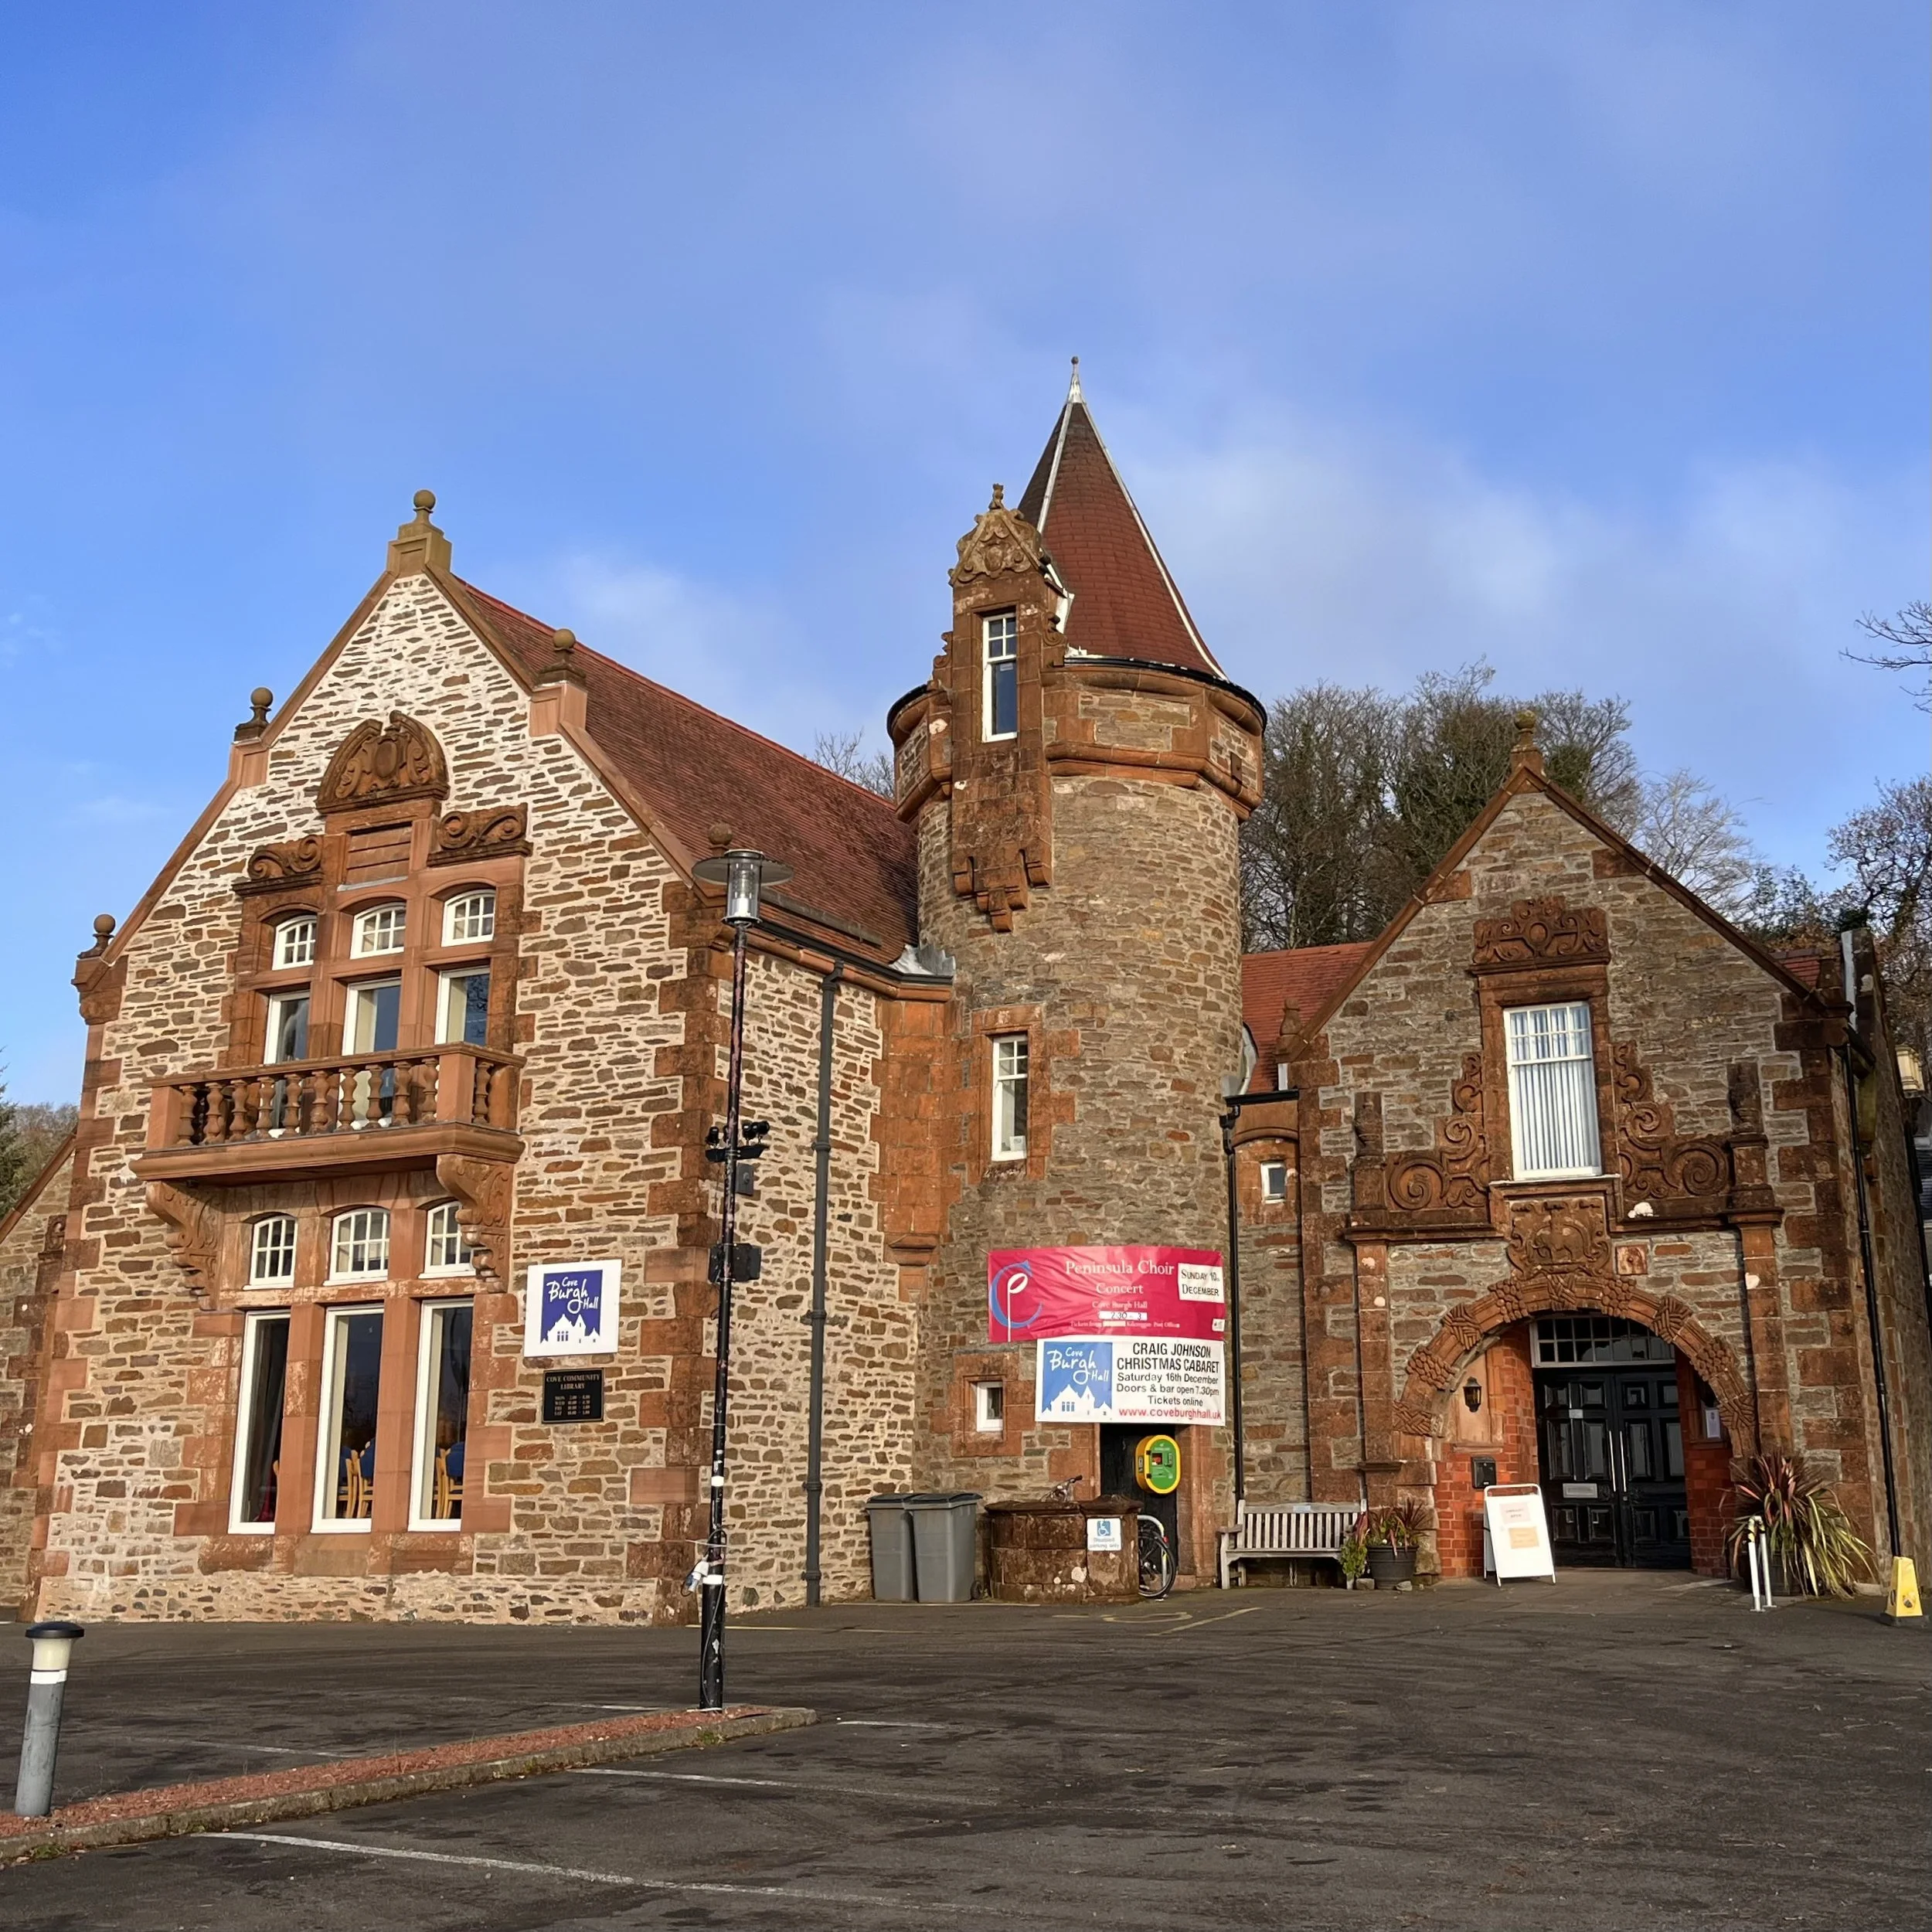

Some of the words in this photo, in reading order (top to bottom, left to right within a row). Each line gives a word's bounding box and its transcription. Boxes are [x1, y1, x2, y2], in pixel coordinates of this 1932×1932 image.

[1066, 1260, 1133, 1275] Peninsula
[1138, 1260, 1174, 1275] Choir
[562, 1277, 578, 1287] Cove
[1096, 1283, 1144, 1294] Concert
[546, 1278, 588, 1314] Burgh
[583, 1296, 599, 1309] Hall
[1066, 1347, 1083, 1356] Cove
[1133, 1342, 1168, 1355] CRAIG
[1171, 1343, 1211, 1358] JOHNSON
[1046, 1349, 1097, 1385] Burgh
[1117, 1358, 1182, 1370] CHRISTMAS
[1183, 1359, 1219, 1373] CABARET
[563, 1373, 600, 1382] COMMUNITY
[1091, 1369, 1109, 1382] Hall
[1117, 1372, 1163, 1383] Saturday
[1166, 1372, 1182, 1382] 16th
[1184, 1373, 1219, 1384] December
[1116, 1383, 1147, 1393] Doors
[1150, 1383, 1157, 1393] &
[1160, 1384, 1175, 1393] bar
[1177, 1386, 1194, 1396] open
[1195, 1386, 1219, 1397] 7.30pm
[1148, 1395, 1181, 1405] Tickets
[1182, 1397, 1203, 1406] online
[1118, 1408, 1222, 1420] www.coveburghhall.uk
